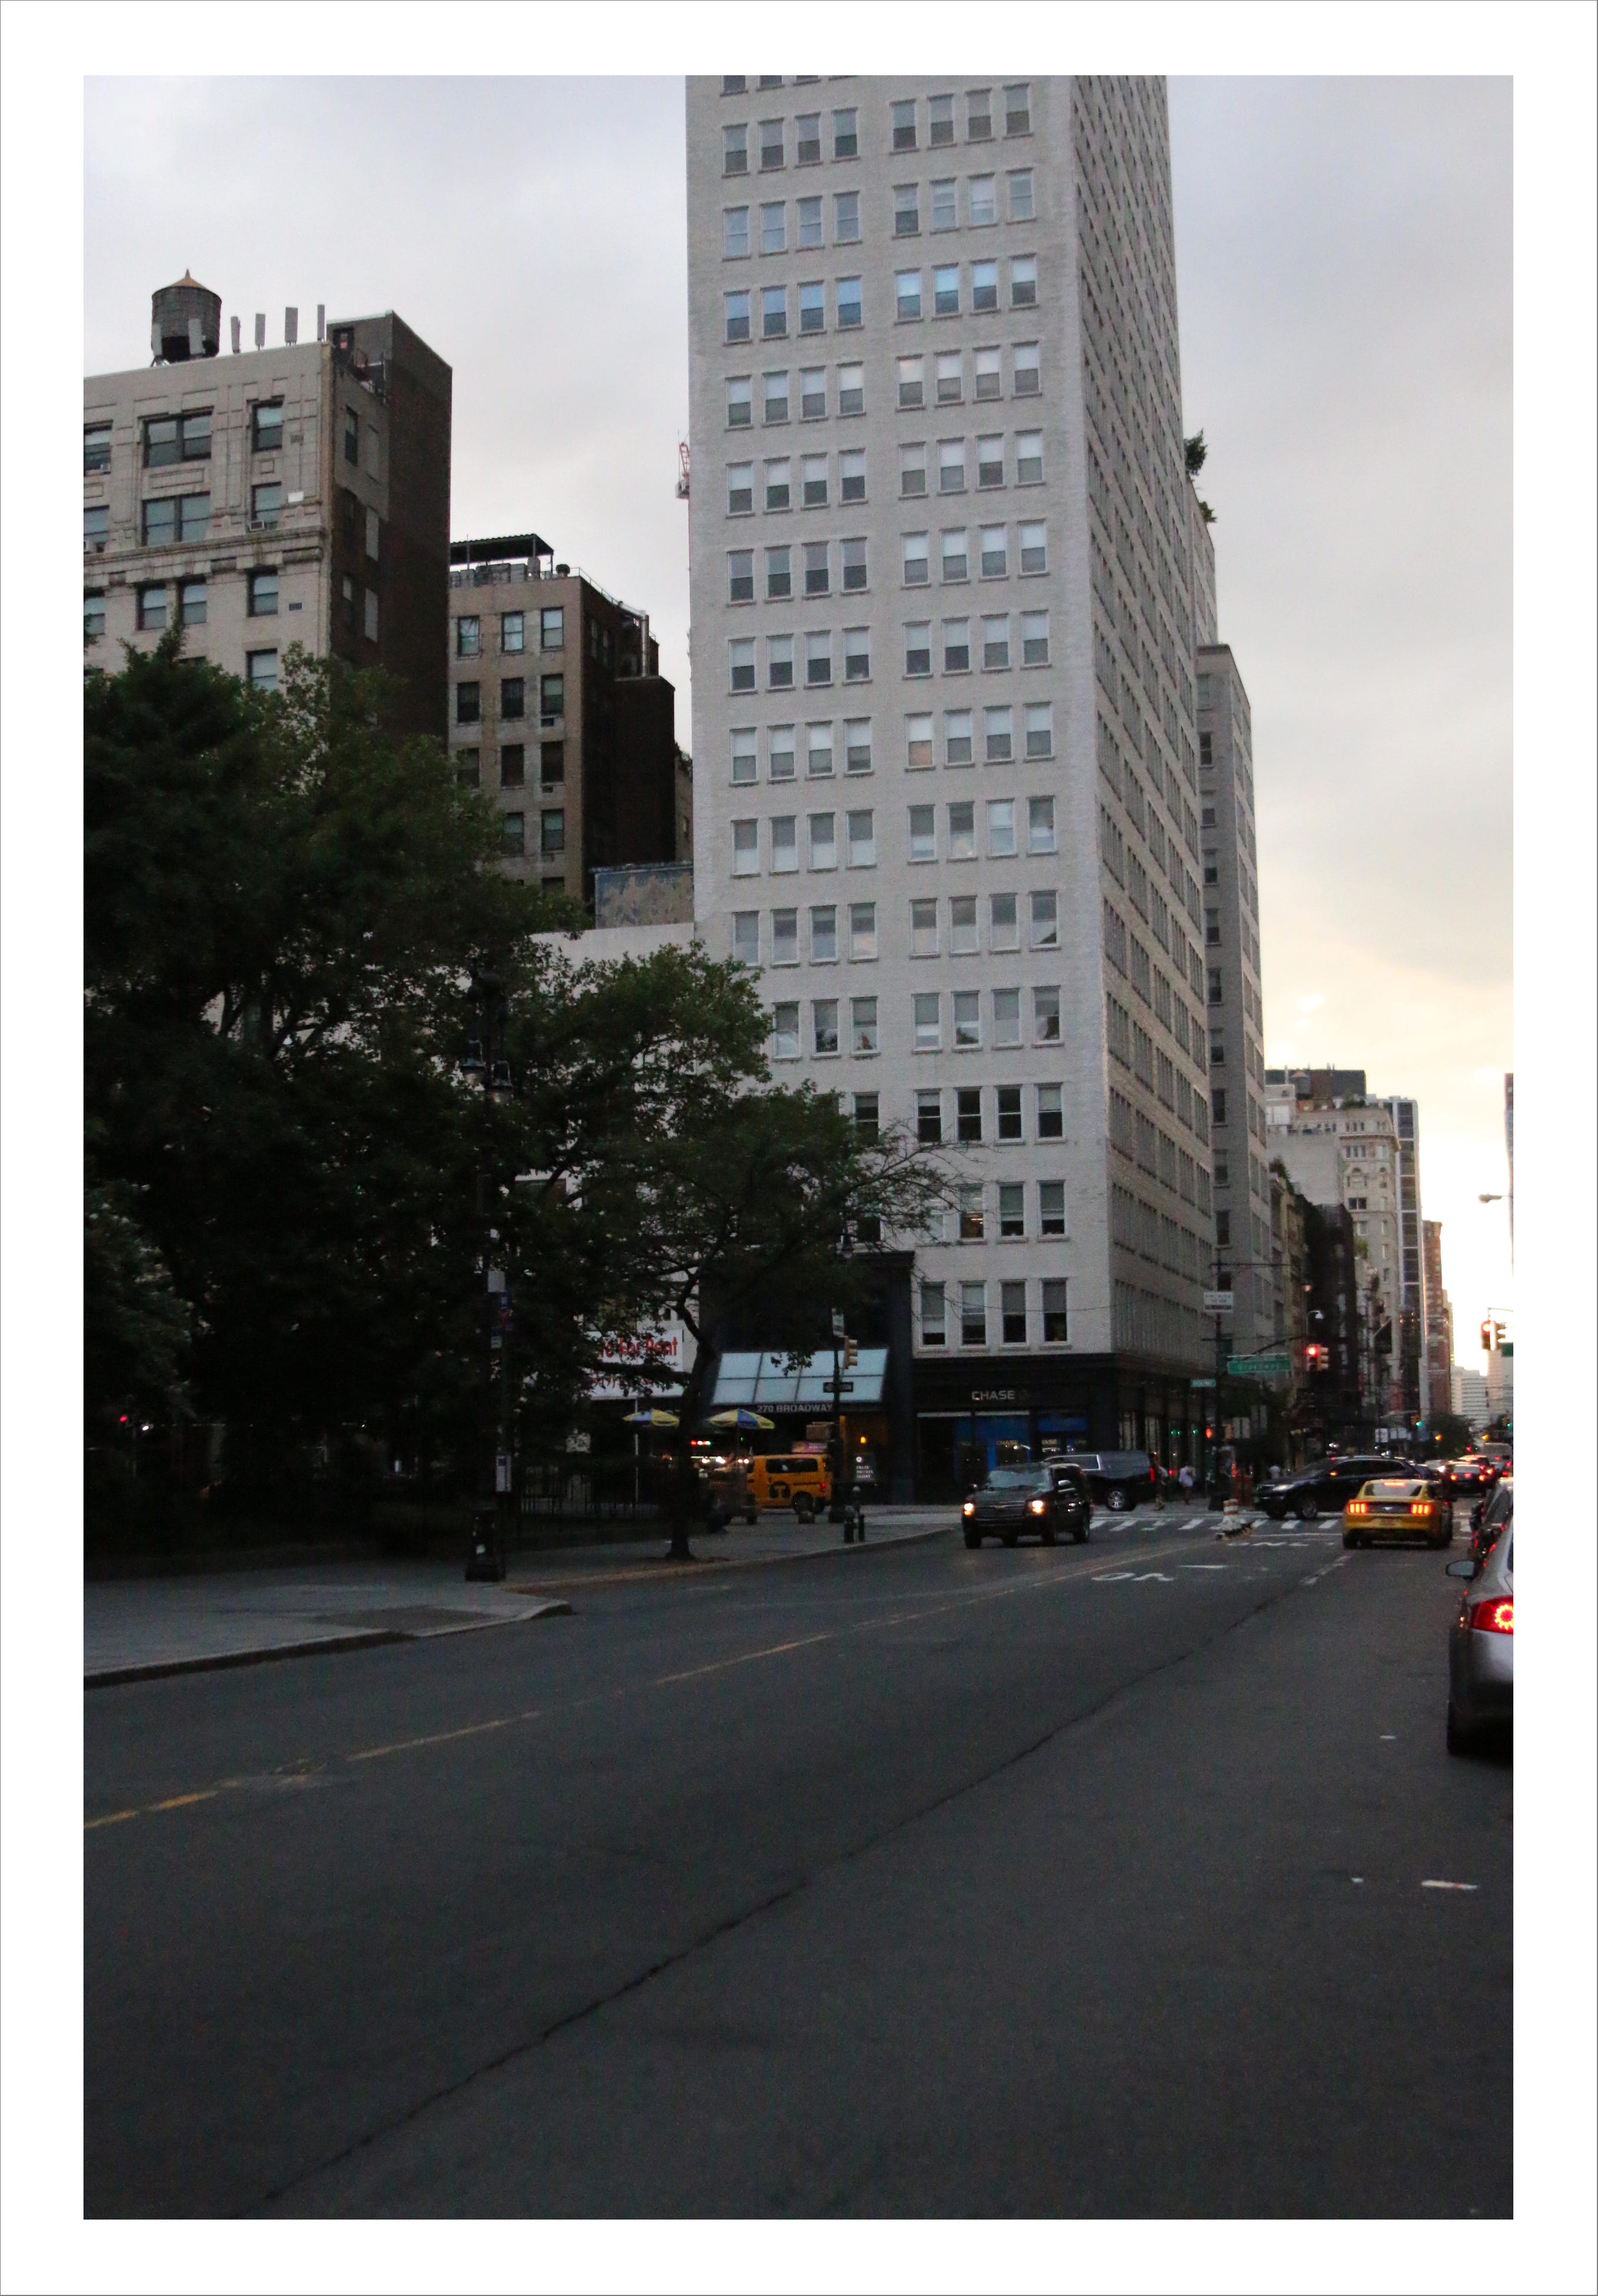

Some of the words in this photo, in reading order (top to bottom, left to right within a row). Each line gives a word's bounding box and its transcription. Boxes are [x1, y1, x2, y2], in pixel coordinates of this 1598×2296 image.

[971, 1390, 1016, 1401] CHASE
[756, 1405, 774, 1413] 270
[775, 1403, 833, 1413] BROADWAY
